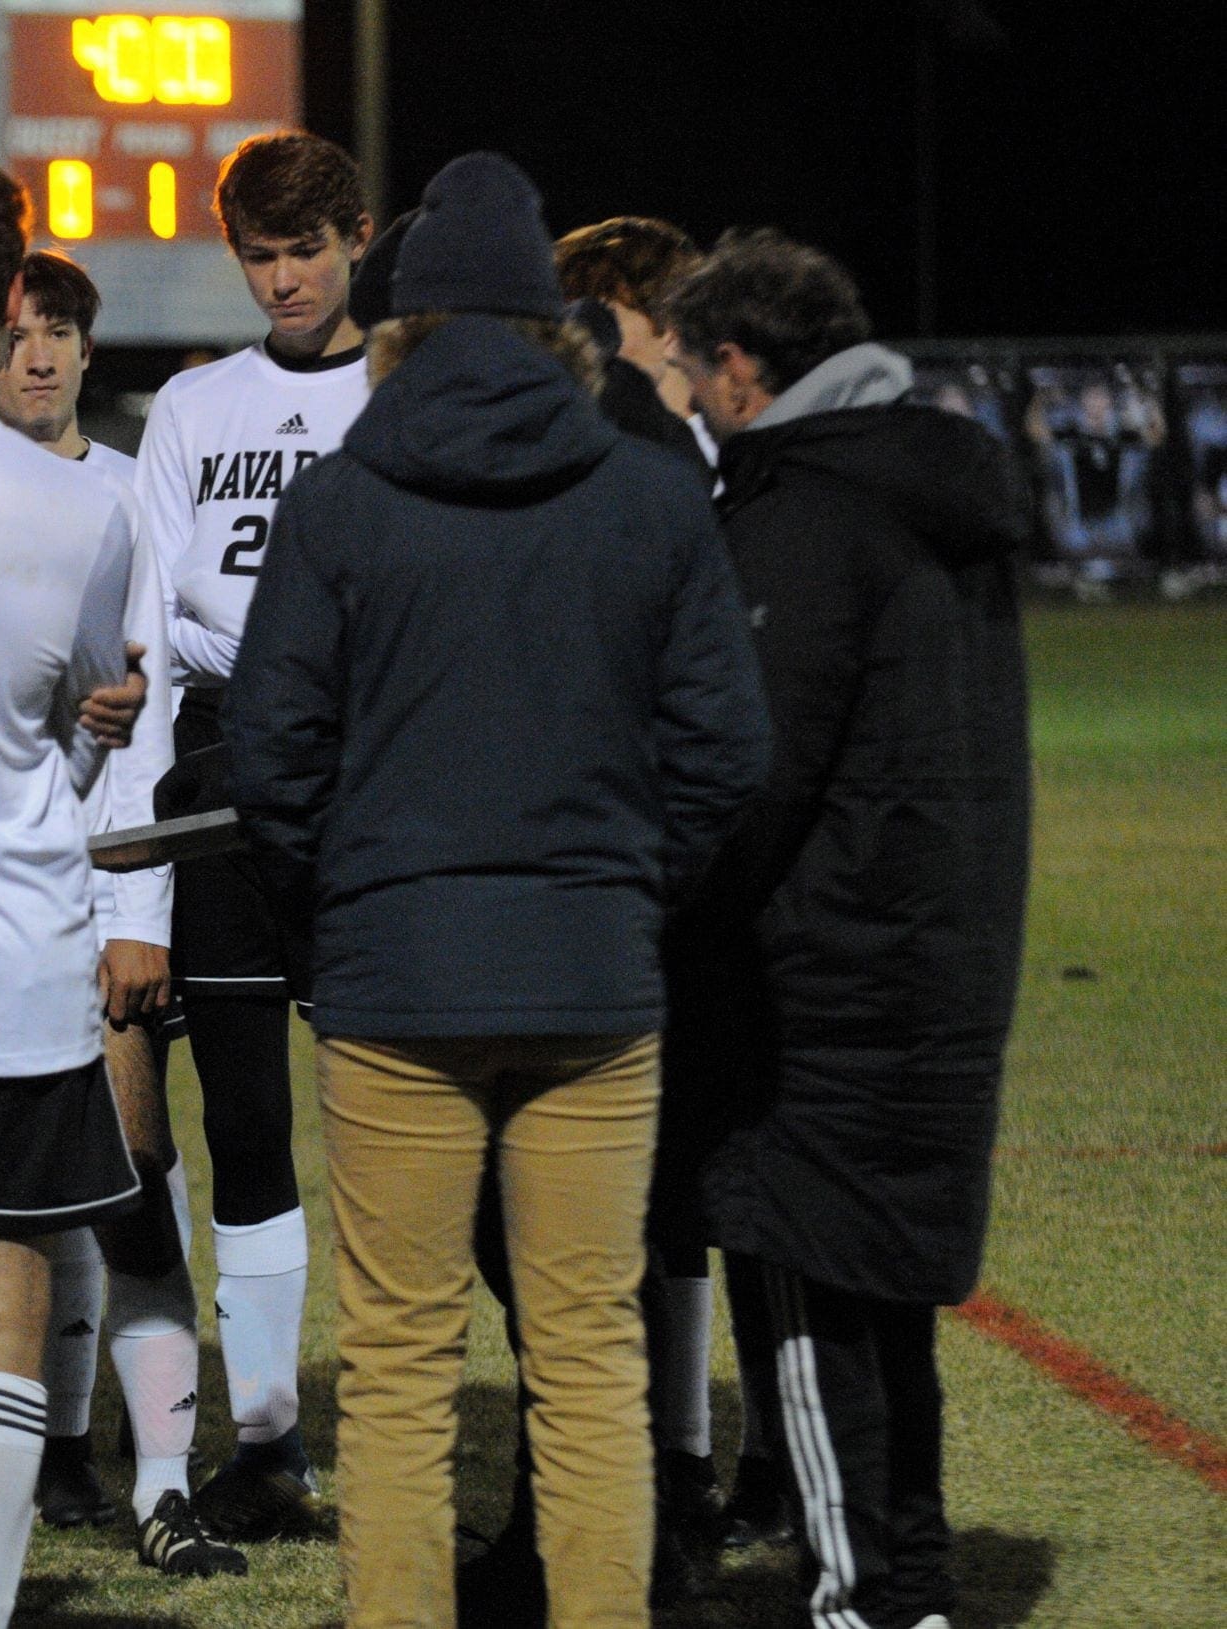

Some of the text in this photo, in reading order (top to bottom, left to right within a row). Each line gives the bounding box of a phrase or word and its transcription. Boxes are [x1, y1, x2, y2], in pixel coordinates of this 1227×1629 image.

[149, 162, 176, 239] 1
[275, 427, 309, 435] adidas
[220, 515, 269, 577] 2
